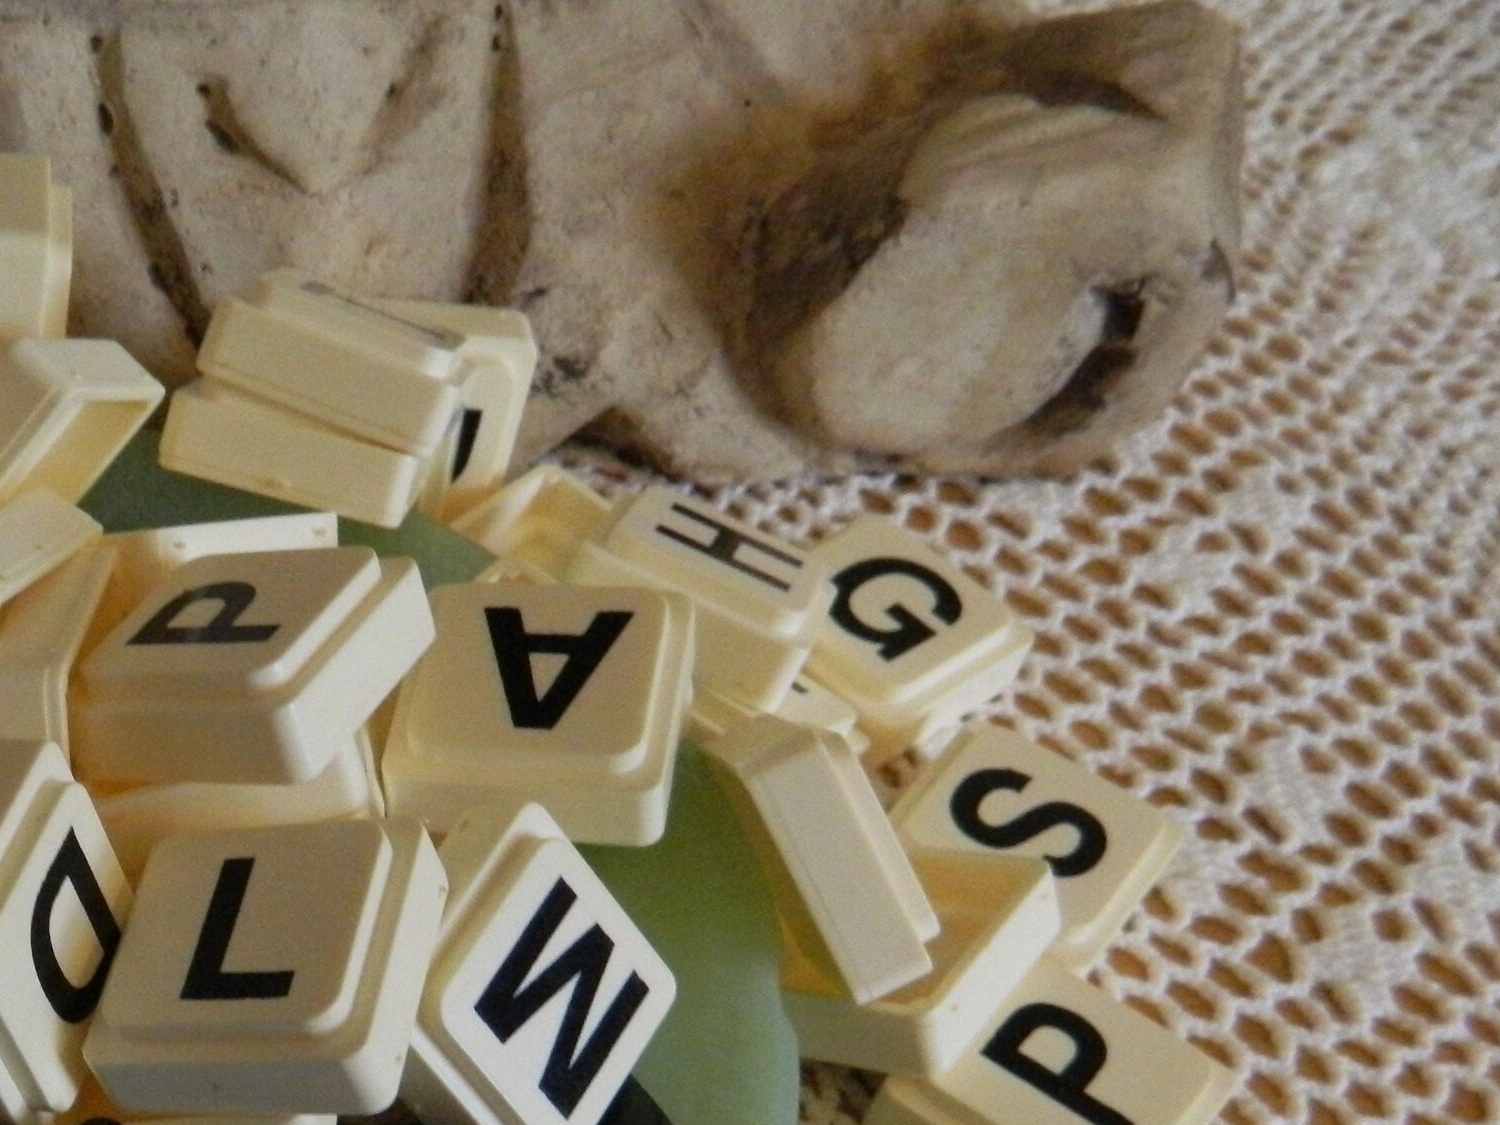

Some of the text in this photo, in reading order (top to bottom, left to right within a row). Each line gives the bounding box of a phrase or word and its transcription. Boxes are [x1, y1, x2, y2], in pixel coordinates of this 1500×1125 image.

[654, 502, 805, 593] H
[124, 580, 284, 647] P
[827, 556, 964, 664] G
[481, 604, 635, 731] A
[947, 767, 1109, 879] S
[178, 855, 296, 1002] L
